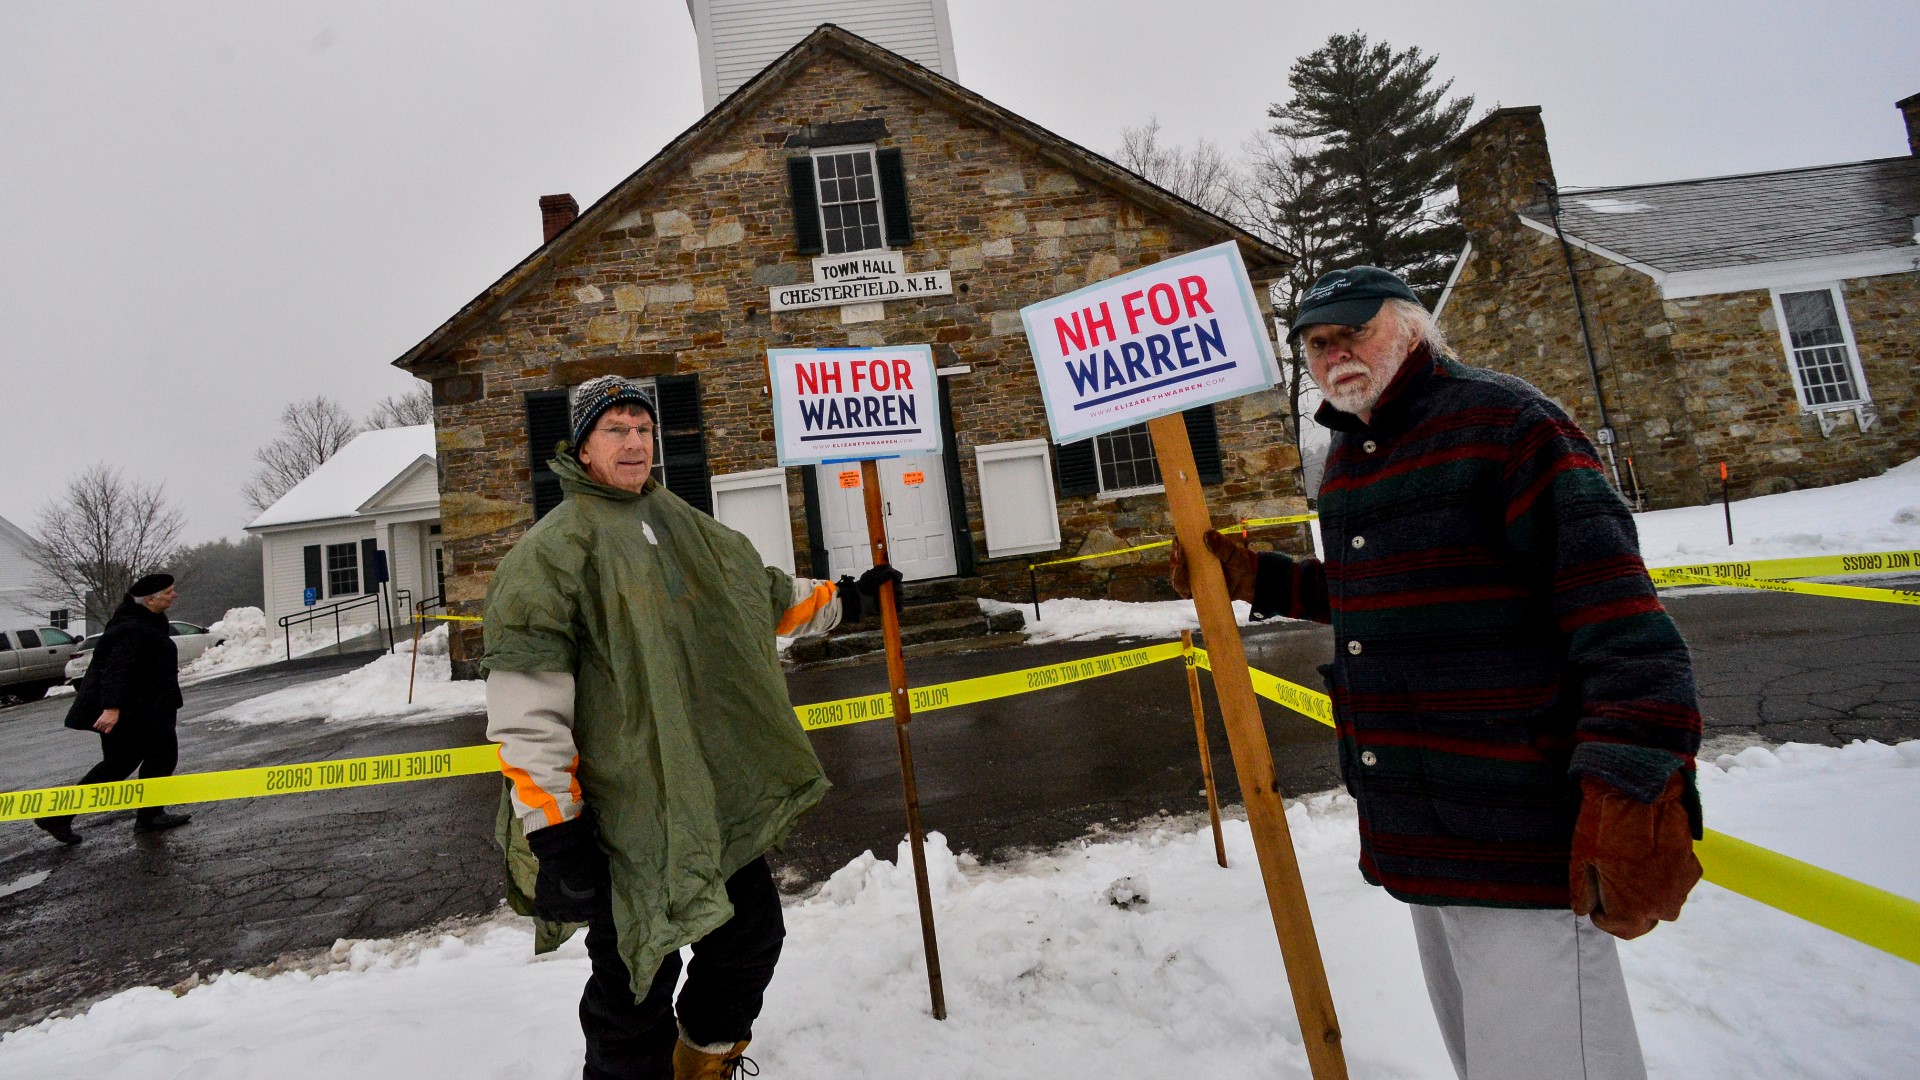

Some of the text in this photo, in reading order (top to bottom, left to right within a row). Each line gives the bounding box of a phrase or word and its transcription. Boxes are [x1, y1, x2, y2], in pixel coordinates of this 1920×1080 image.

[821, 260, 896, 280] TOWN HALL
[1054, 275, 1215, 357] NH FOR
[1065, 318, 1228, 397] WARREN
[794, 359, 914, 395] NH FOR
[799, 394, 917, 432] WARREN
[1713, 563, 1751, 577] POLICE
[1843, 554, 1882, 571] CROSS
[1886, 553, 1910, 568] NOT
